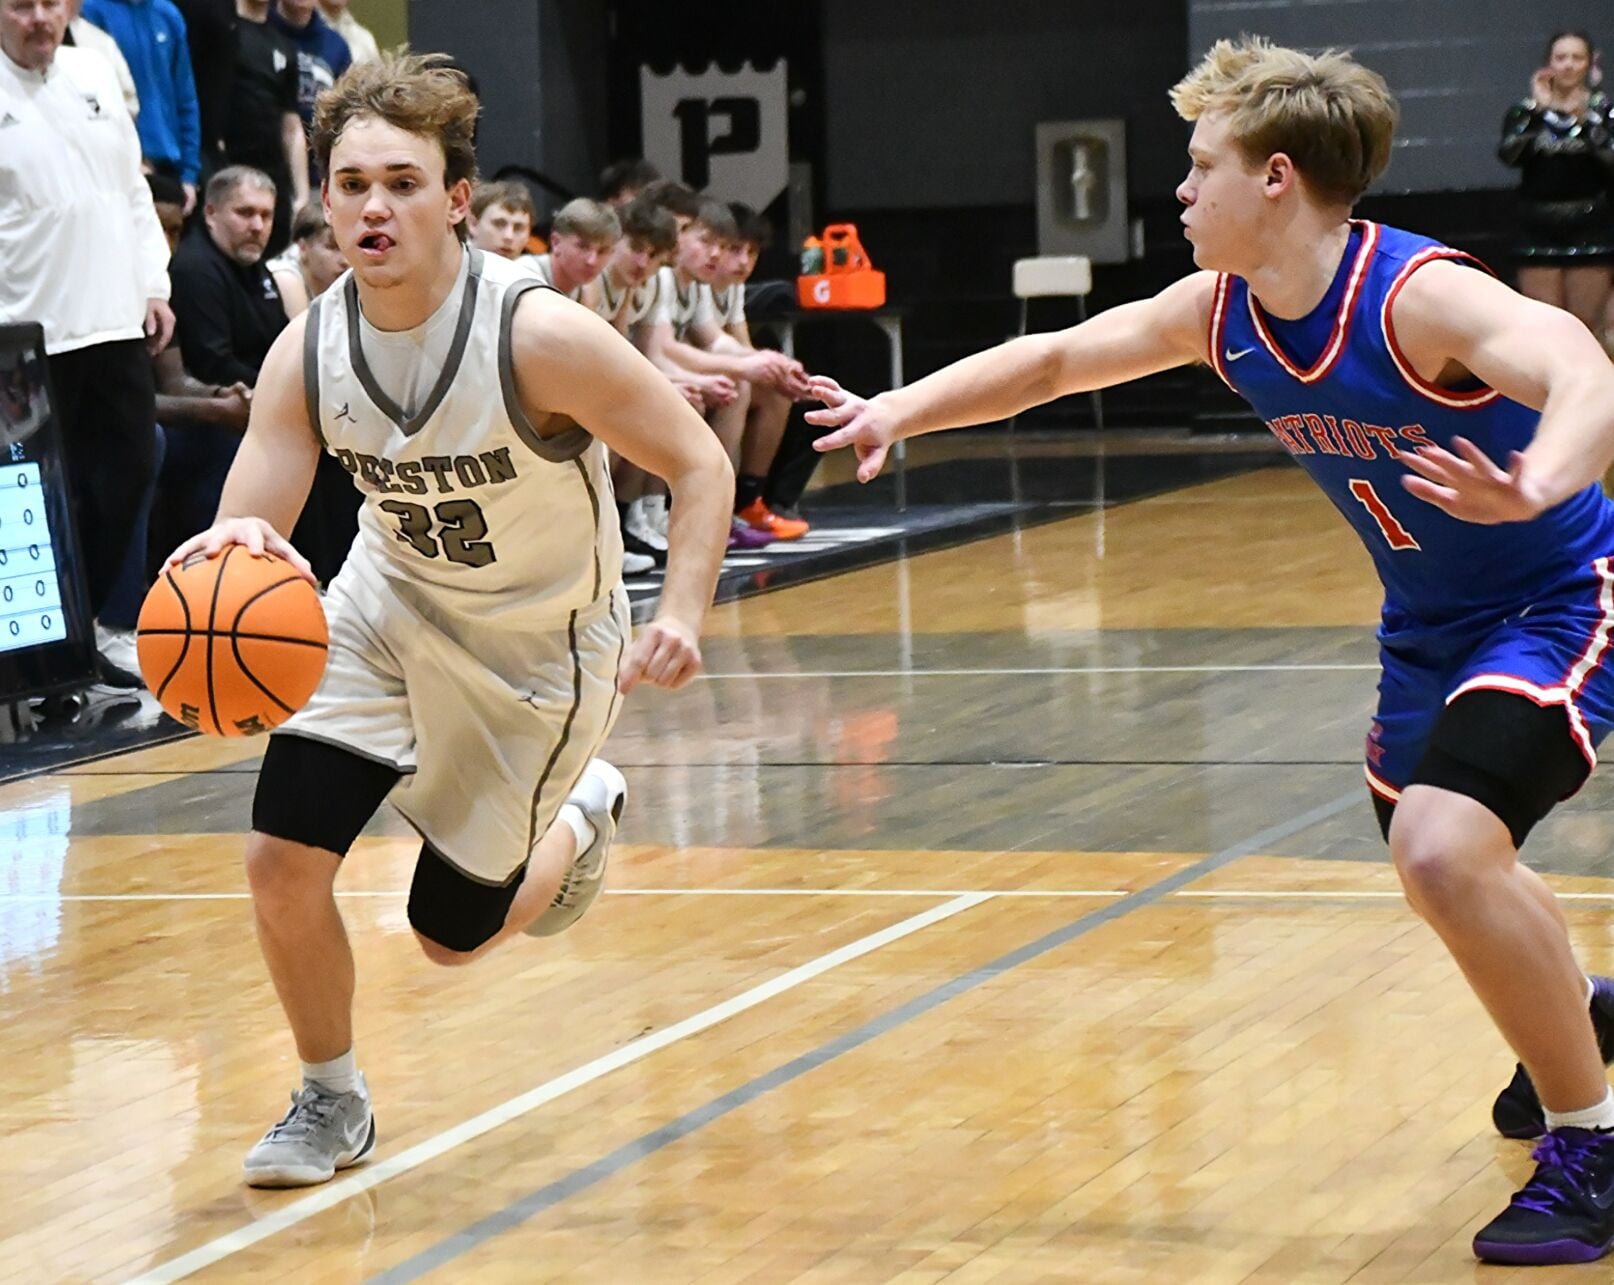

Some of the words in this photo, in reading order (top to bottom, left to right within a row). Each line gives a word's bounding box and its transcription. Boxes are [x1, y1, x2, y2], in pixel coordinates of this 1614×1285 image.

[671, 96, 761, 192] P
[813, 279, 831, 304] G
[17, 472, 28, 488] 0
[335, 447, 518, 495] PRESTON
[23, 508, 33, 526] 0
[1349, 478, 1422, 551] 1
[379, 499, 497, 568] 32
[29, 544, 40, 561] 0
[3, 585, 13, 602] 0
[35, 579, 45, 597] 0
[9, 620, 20, 636] 0
[41, 614, 51, 630] 0
